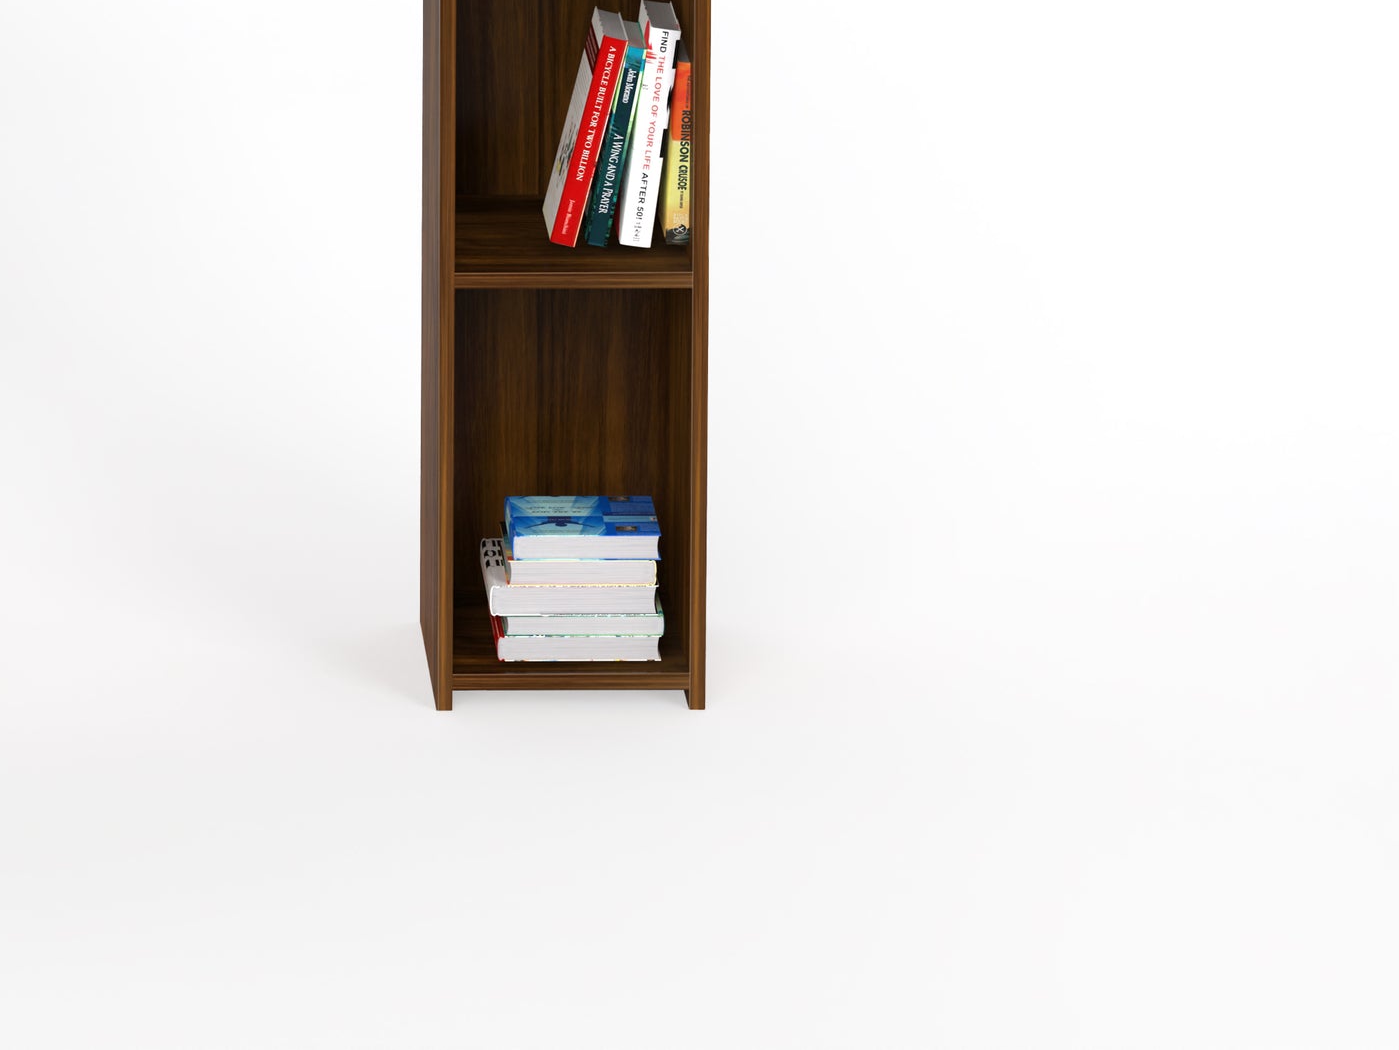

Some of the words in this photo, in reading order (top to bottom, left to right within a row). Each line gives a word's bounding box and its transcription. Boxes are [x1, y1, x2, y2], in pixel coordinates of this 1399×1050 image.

[659, 30, 669, 53] FIND
[600, 53, 616, 86] BICYCLE
[625, 68, 637, 82] John
[656, 55, 666, 74] THE
[593, 86, 607, 111] BUILT
[652, 76, 662, 102] LOVE
[589, 111, 600, 128] FOR
[650, 104, 659, 118] OF
[582, 128, 596, 149] TWO
[646, 120, 657, 147] YOUR
[679, 110, 692, 162] ROBINSON
[609, 140, 624, 163] WING
[642, 149, 652, 170] LIFE
[575, 149, 590, 181] BILLION
[605, 163, 617, 181] AND
[638, 172, 649, 204] AFTER
[677, 165, 689, 191] CRUSOE
[598, 188, 613, 214] PRAYER
[635, 206, 644, 220] 50!
